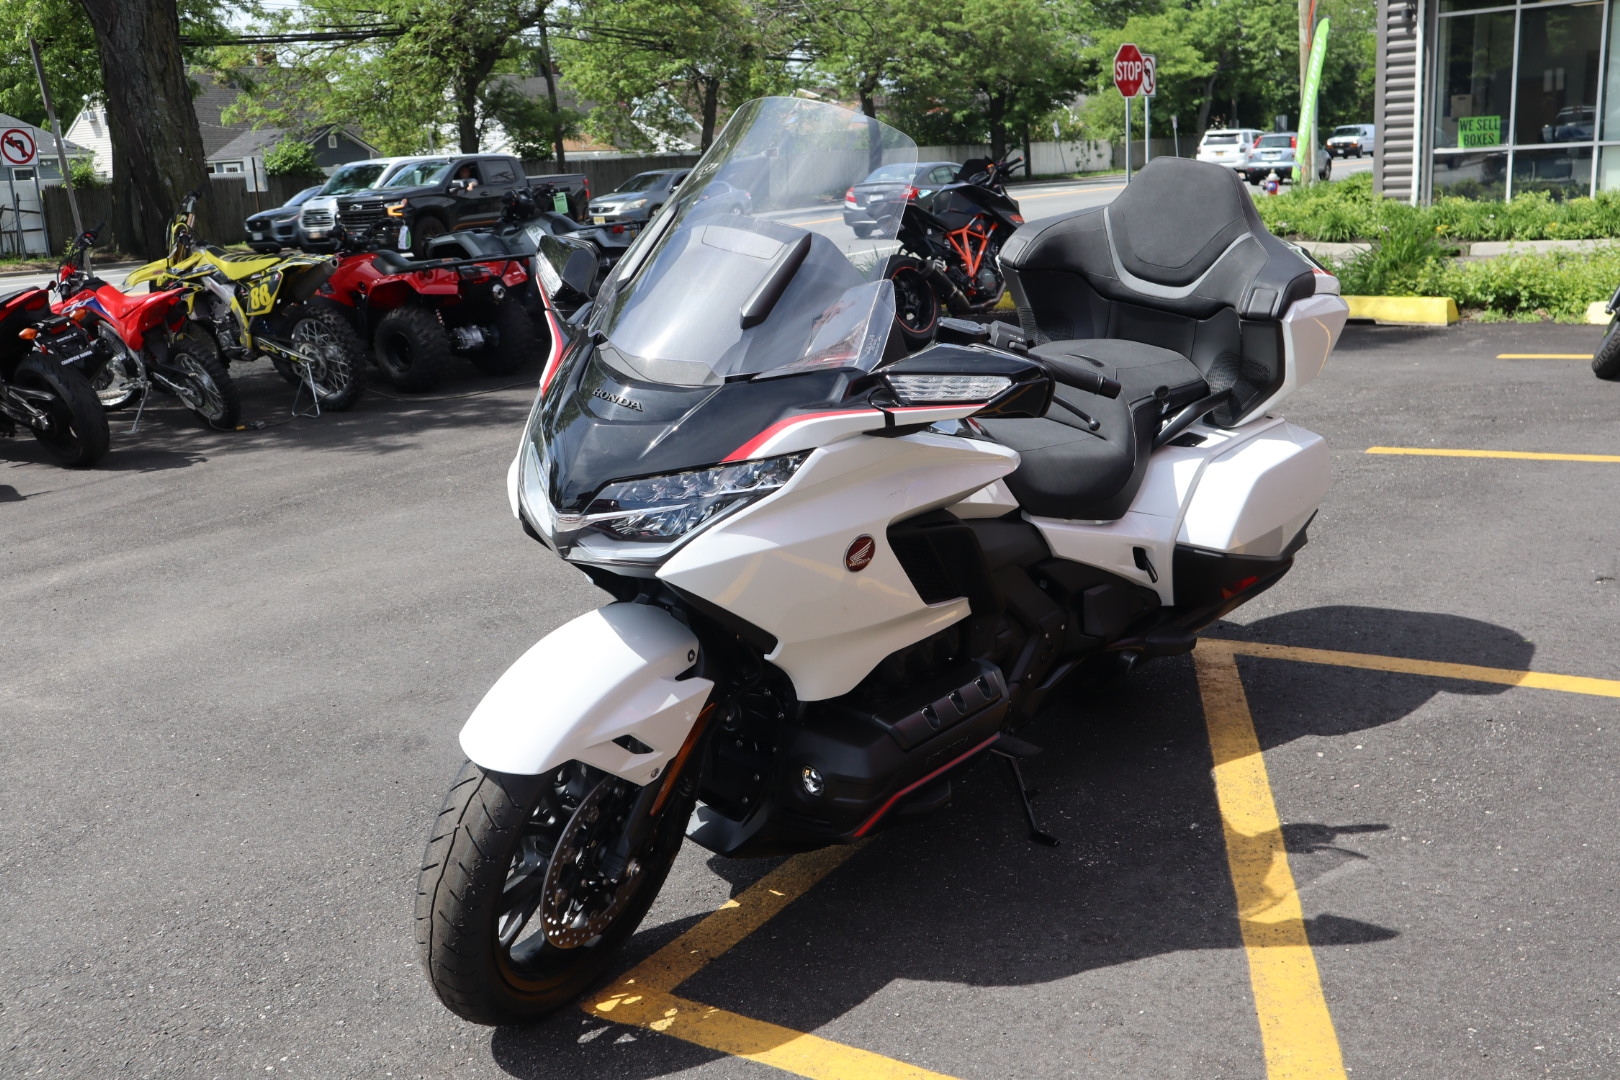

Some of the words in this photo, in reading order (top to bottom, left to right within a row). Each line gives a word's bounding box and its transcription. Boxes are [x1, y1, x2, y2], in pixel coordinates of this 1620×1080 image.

[1116, 61, 1142, 81] STOP
[1460, 119, 1473, 131] WE
[1477, 118, 1499, 131] SELL
[1464, 133, 1495, 146] BOXES
[250, 283, 271, 310] 88
[592, 387, 643, 412] HONDA
[849, 558, 870, 567] HONDA
